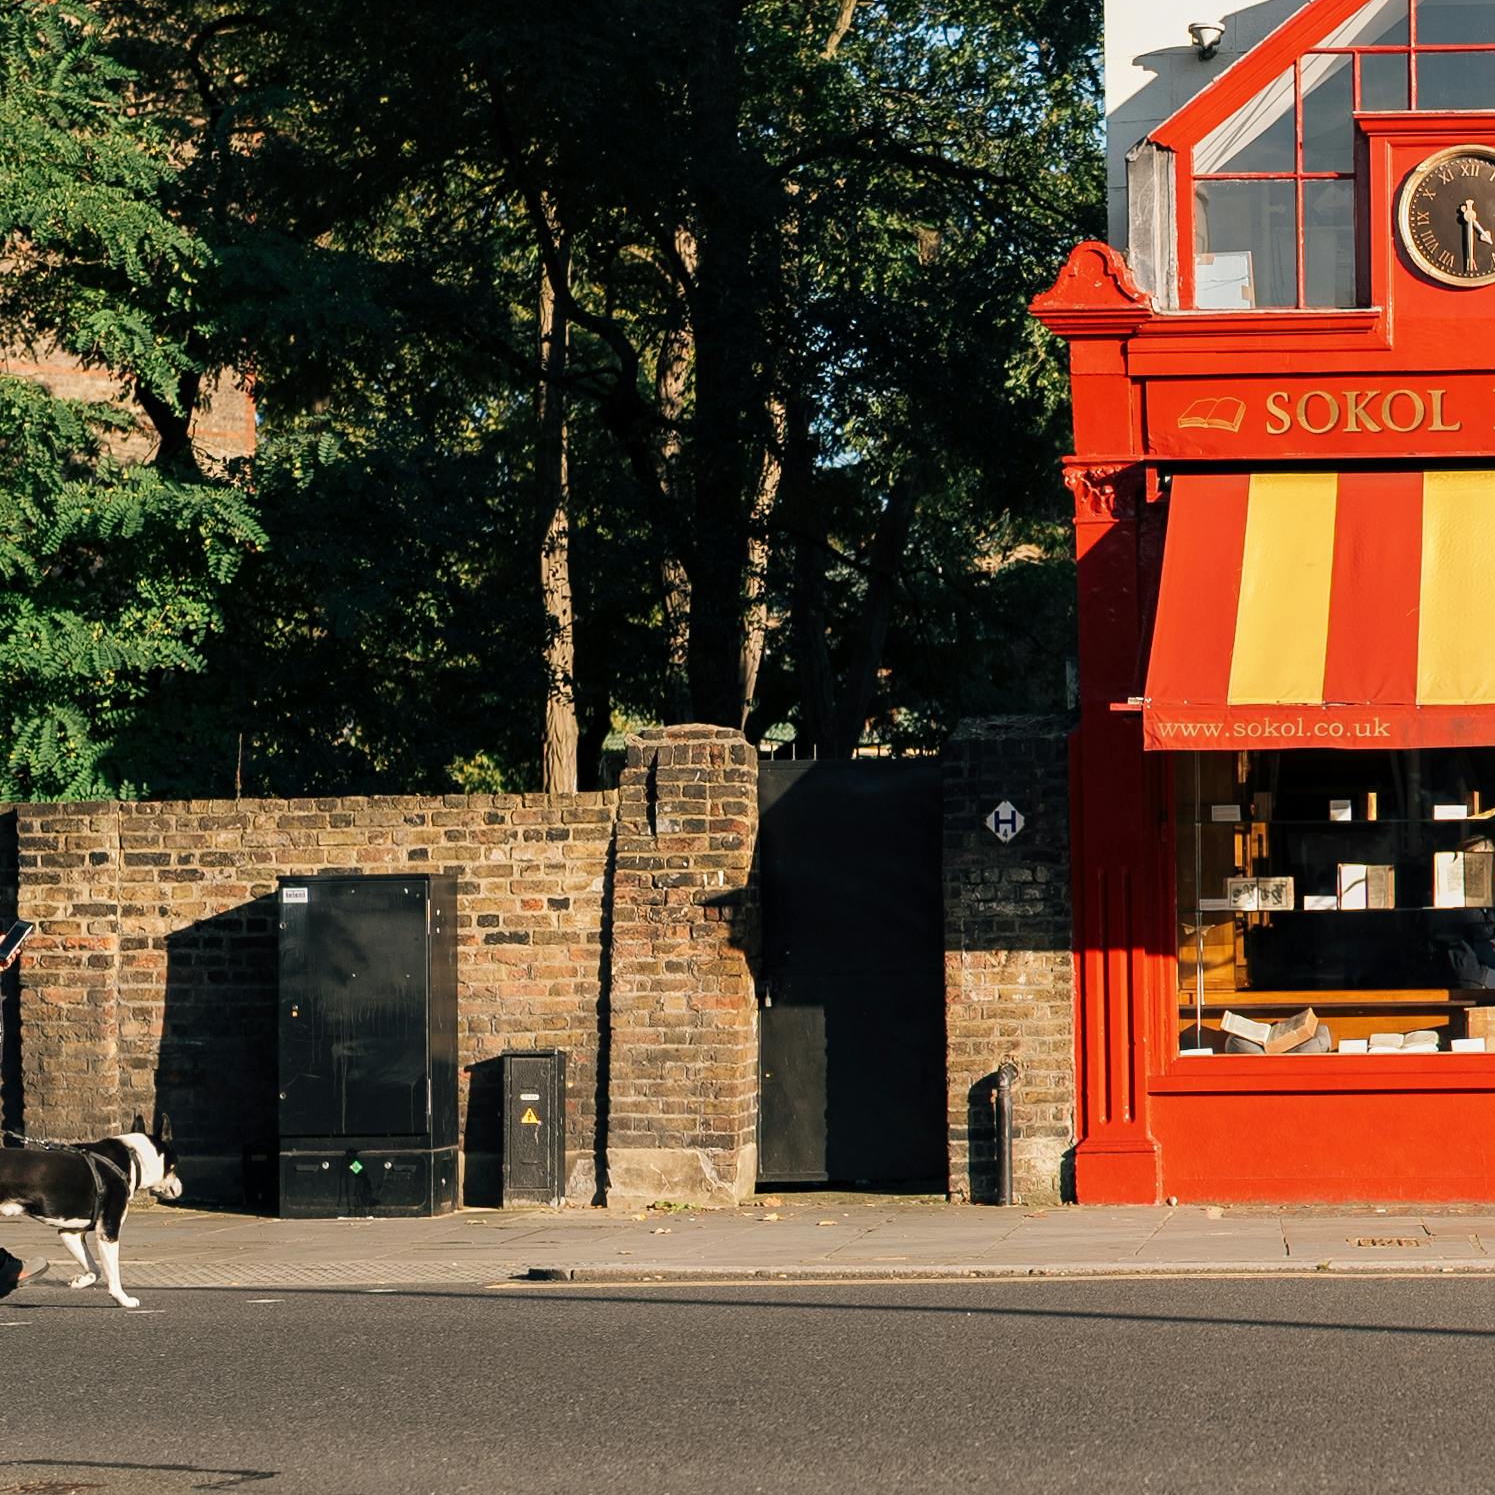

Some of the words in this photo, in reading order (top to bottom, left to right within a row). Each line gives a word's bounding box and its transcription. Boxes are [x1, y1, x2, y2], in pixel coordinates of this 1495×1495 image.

[1438, 169, 1454, 184] XI
[1461, 165, 1480, 176] XII
[1422, 188, 1436, 201] X
[1417, 211, 1430, 225] IX
[1421, 230, 1439, 254] VIII
[1438, 250, 1455, 267] VII
[1265, 389, 1462, 435] SOKOL
[1158, 717, 1391, 737] www.sokol.co.uk
[994, 810, 1016, 833] H
